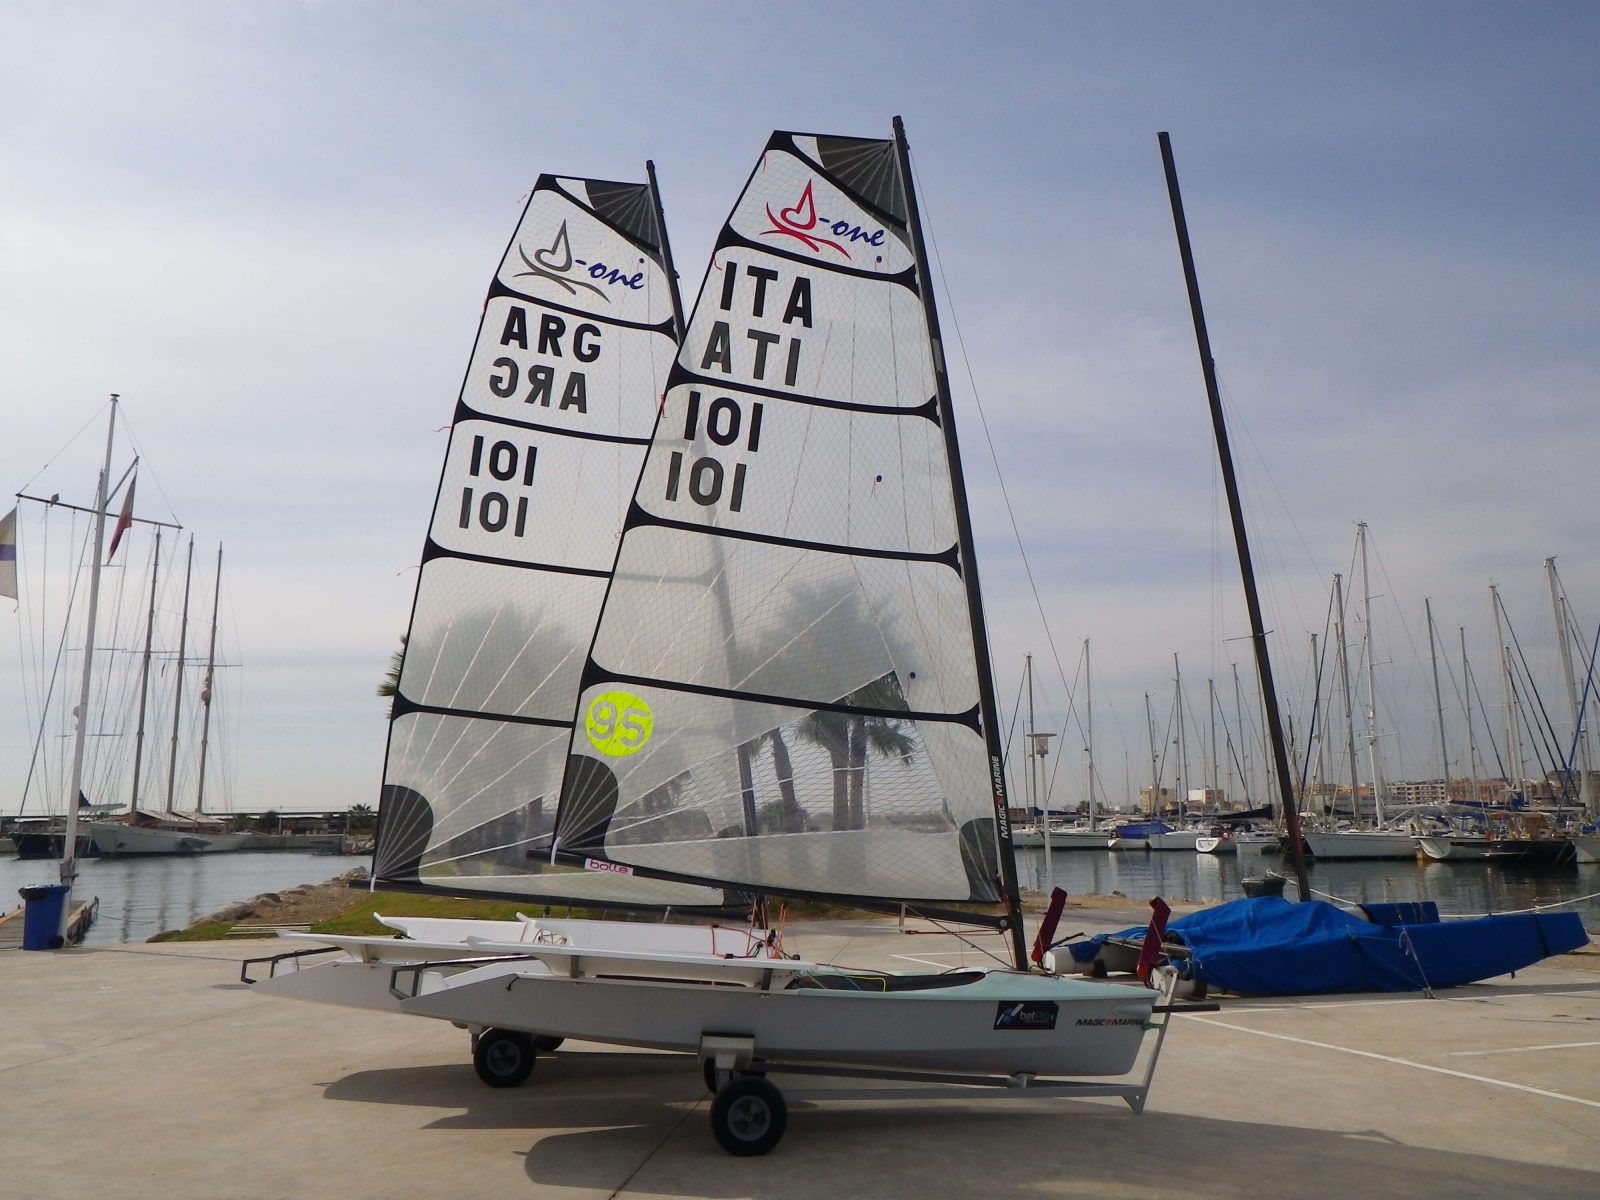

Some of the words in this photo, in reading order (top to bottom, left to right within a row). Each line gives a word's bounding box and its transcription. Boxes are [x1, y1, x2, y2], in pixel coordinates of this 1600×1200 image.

[720, 261, 812, 328] ITA
[500, 305, 602, 363] ARG
[991, 755, 1004, 796] MARINE
[998, 804, 1009, 839] MAGIC
[1075, 1018, 1105, 1026] MAGIC
